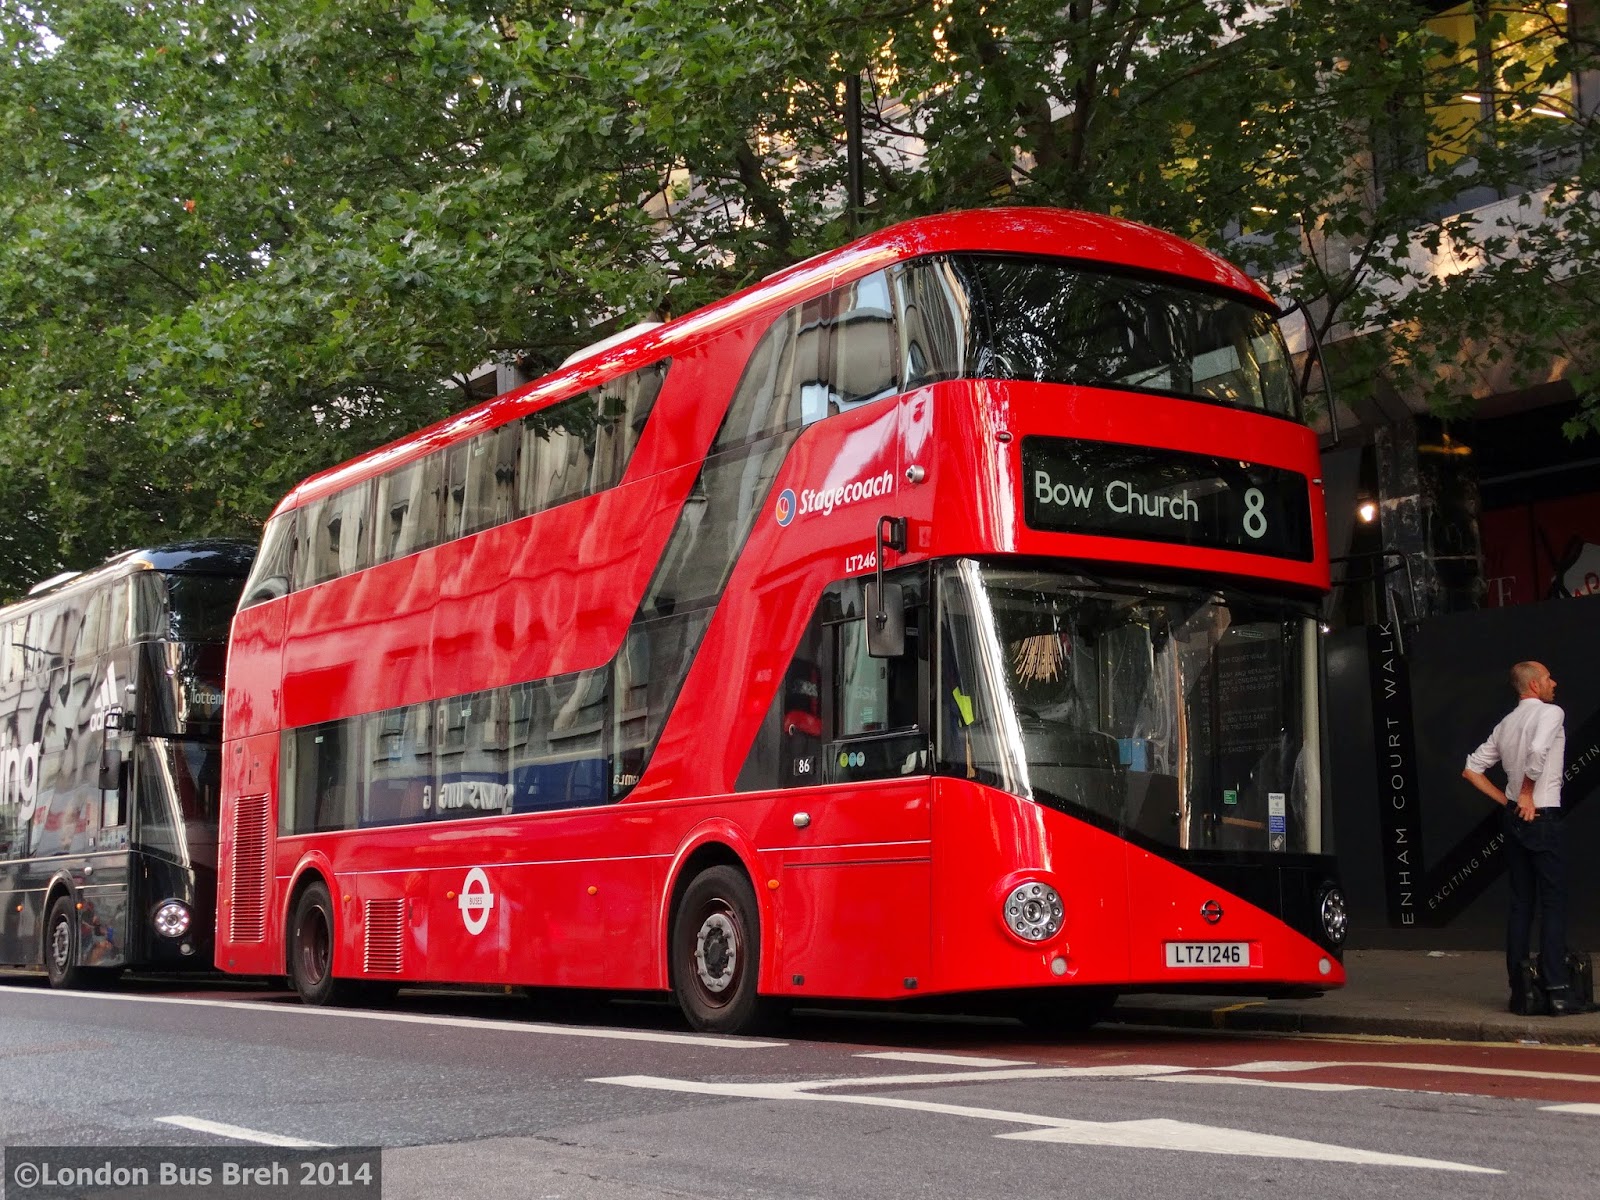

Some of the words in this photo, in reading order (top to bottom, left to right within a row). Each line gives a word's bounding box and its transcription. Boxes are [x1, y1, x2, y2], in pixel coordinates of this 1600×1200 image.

[799, 470, 893, 516] Stagecoach
[1035, 471, 1094, 508] Bow
[1106, 481, 1199, 522] Church
[1243, 487, 1268, 539] 8
[845, 551, 876, 573] LT246
[1380, 622, 1397, 699] WALK
[798, 758, 810, 773] 86
[1386, 717, 1406, 810] COURT
[469, 897, 483, 905] BUSES
[1395, 828, 1414, 925] ENHAM
[1428, 858, 1479, 909] EXCITING
